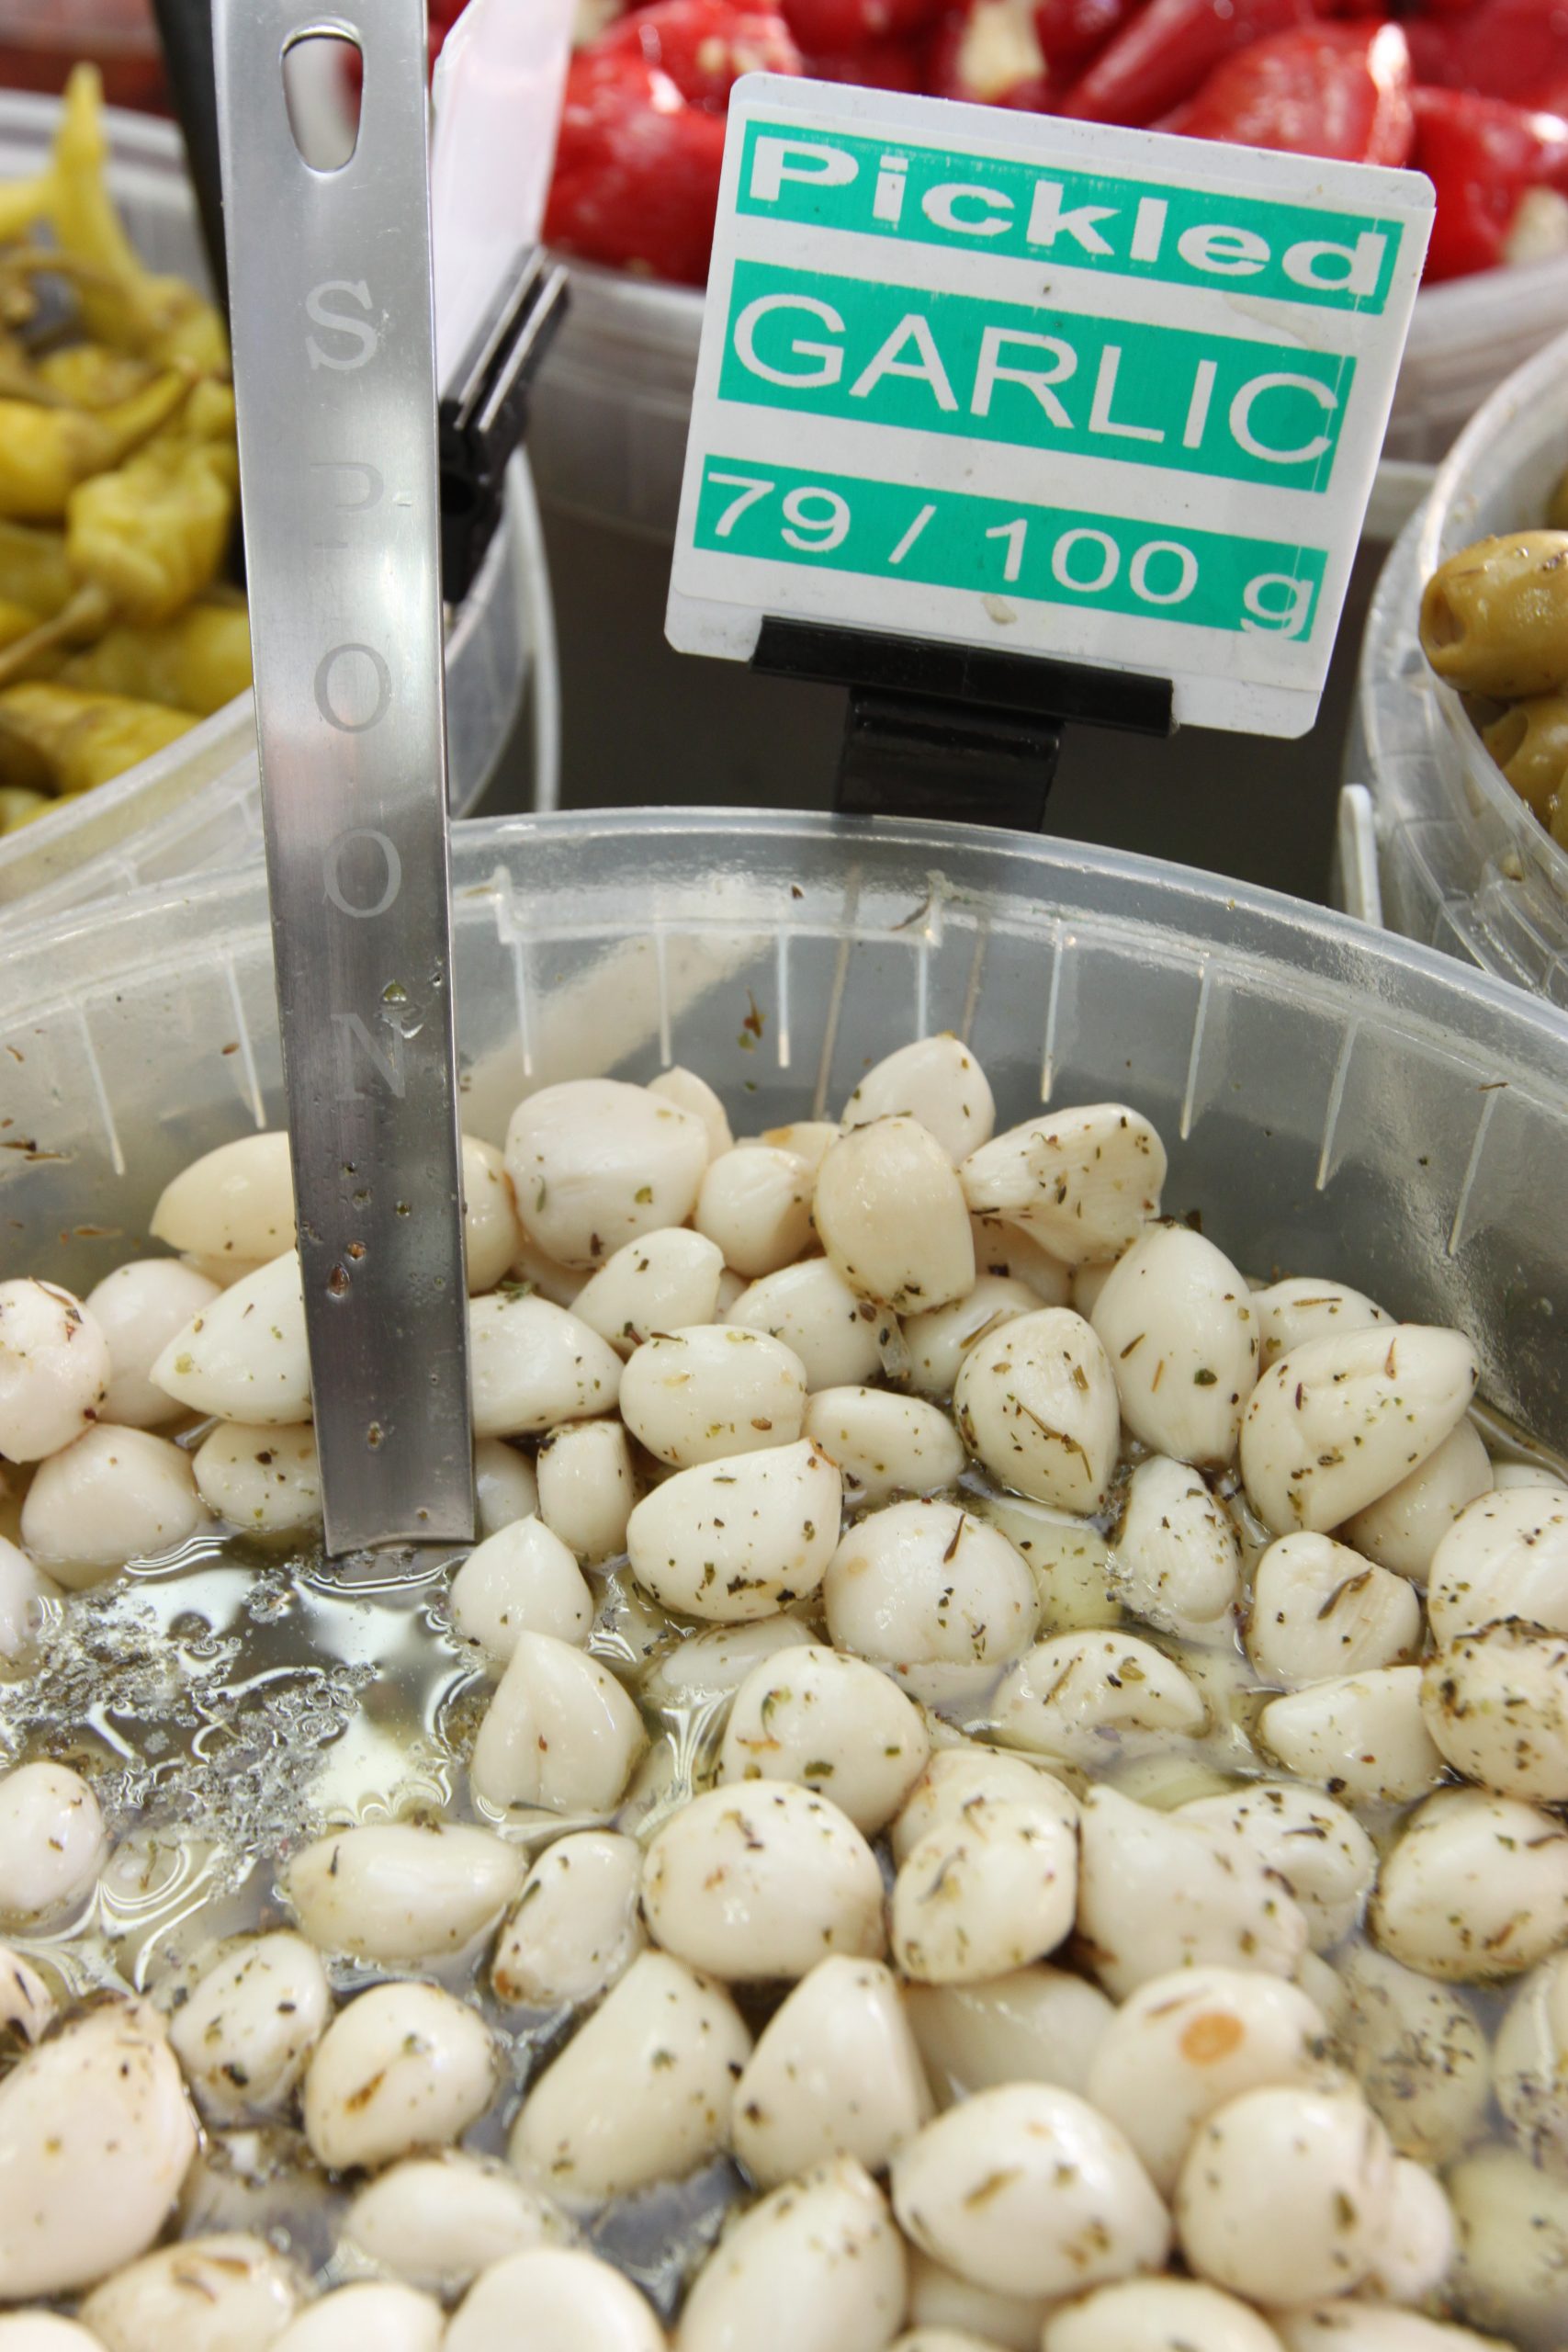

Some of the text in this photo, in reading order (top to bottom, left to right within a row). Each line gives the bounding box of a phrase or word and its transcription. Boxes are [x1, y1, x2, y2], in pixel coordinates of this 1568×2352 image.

[748, 135, 1387, 297] Pickled
[733, 293, 1339, 464] GARLIC
[705, 472, 1315, 639] 79 / 100 g
[305, 279, 409, 1101] SPOON
